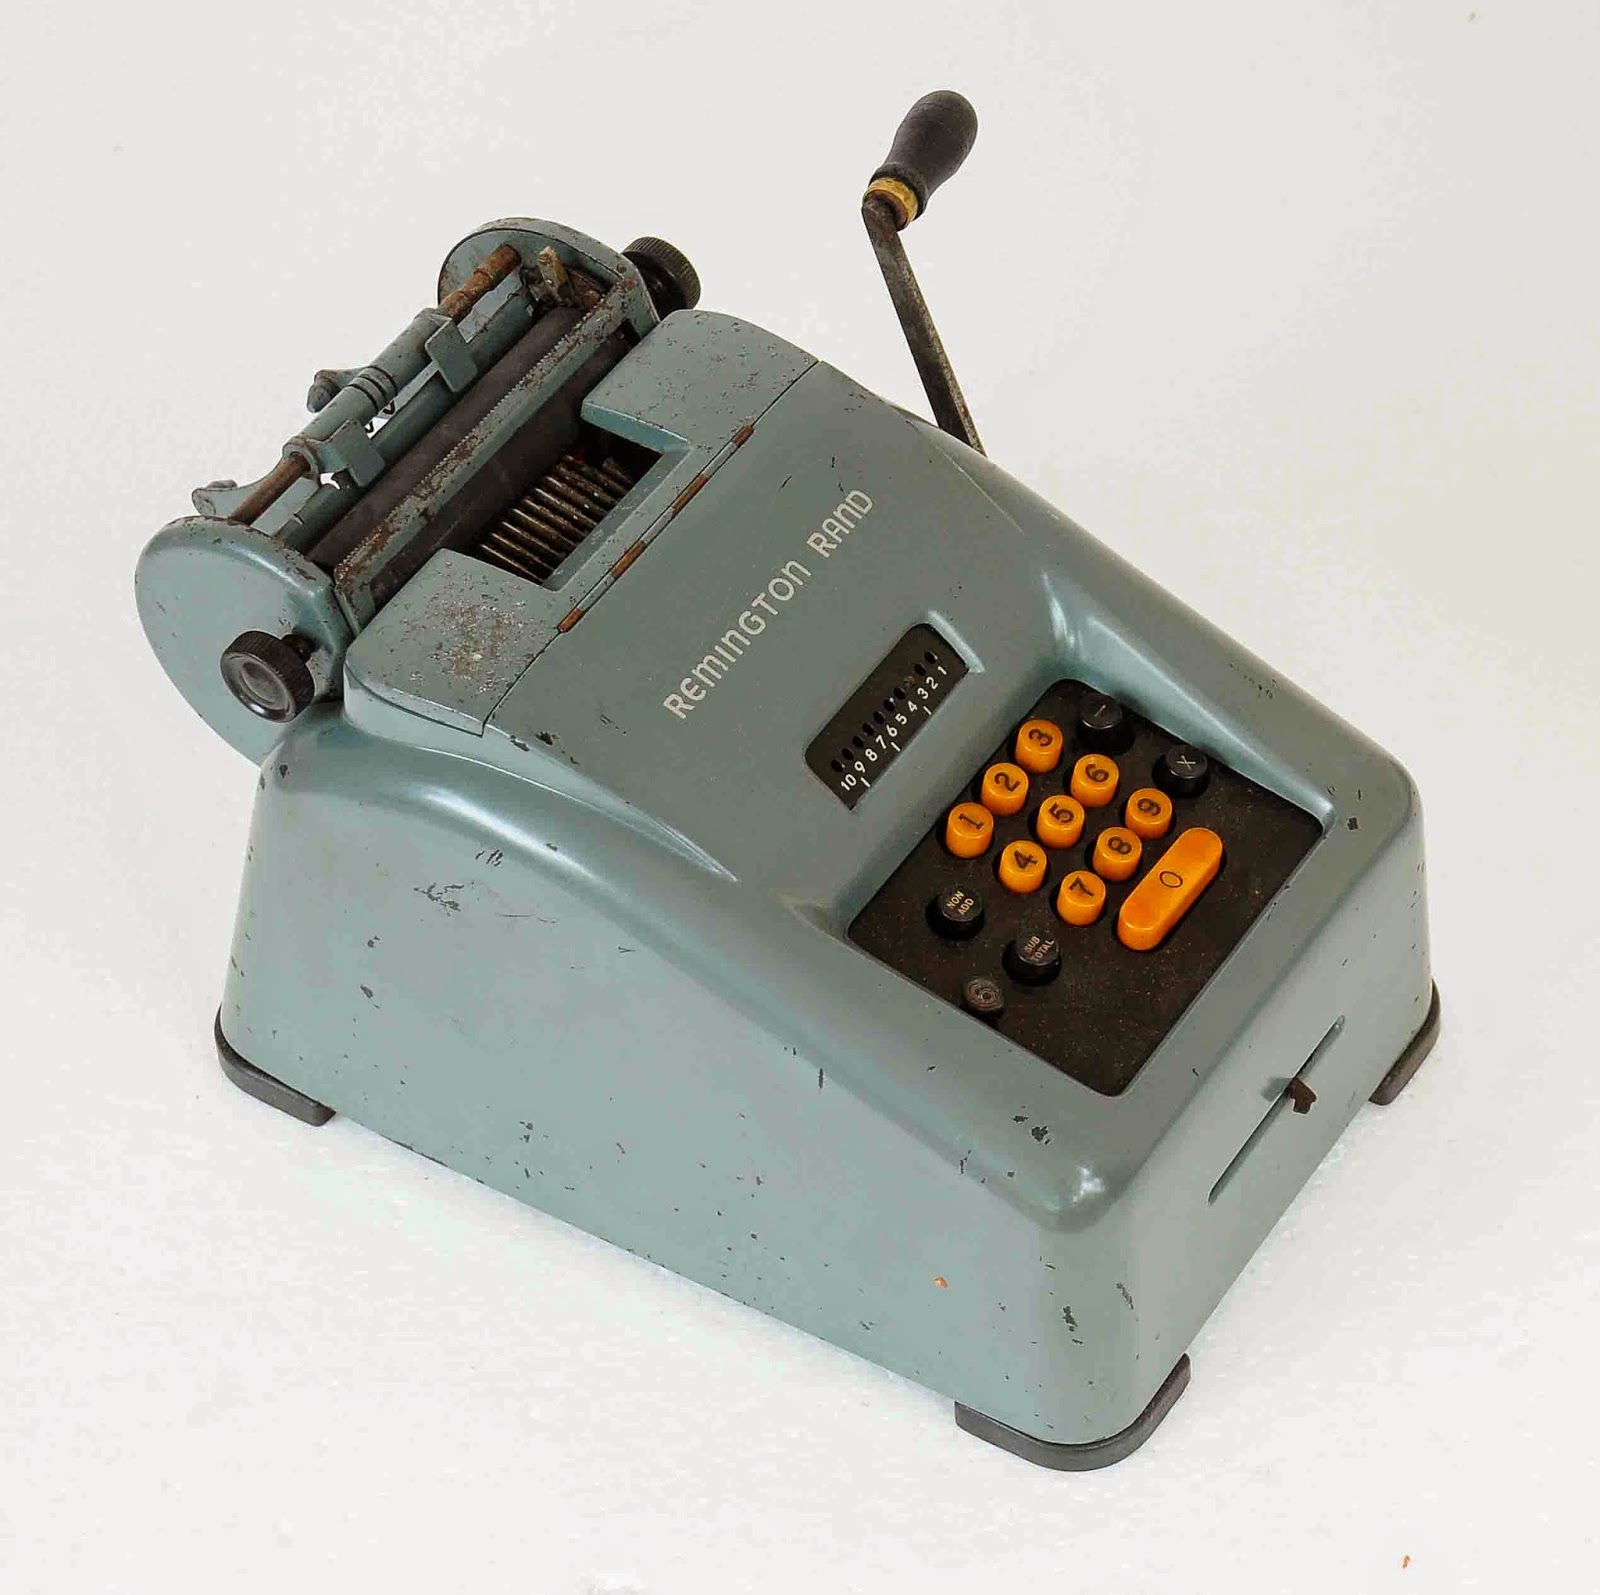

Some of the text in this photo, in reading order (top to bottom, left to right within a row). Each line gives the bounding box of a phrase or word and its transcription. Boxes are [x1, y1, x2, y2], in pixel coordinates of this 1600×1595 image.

[840, 665, 948, 791] 10 9 8 7 6 5 4 3 2 1
[958, 728, 1053, 830] 1 2 3
[1013, 763, 1110, 870] 4 5 6
[1068, 798, 1162, 898] 7 8 9
[946, 890, 965, 909] NON
[957, 898, 974, 915] ADD
[1024, 936, 1041, 953] SUB
[1031, 939, 1055, 962] TOTAL
